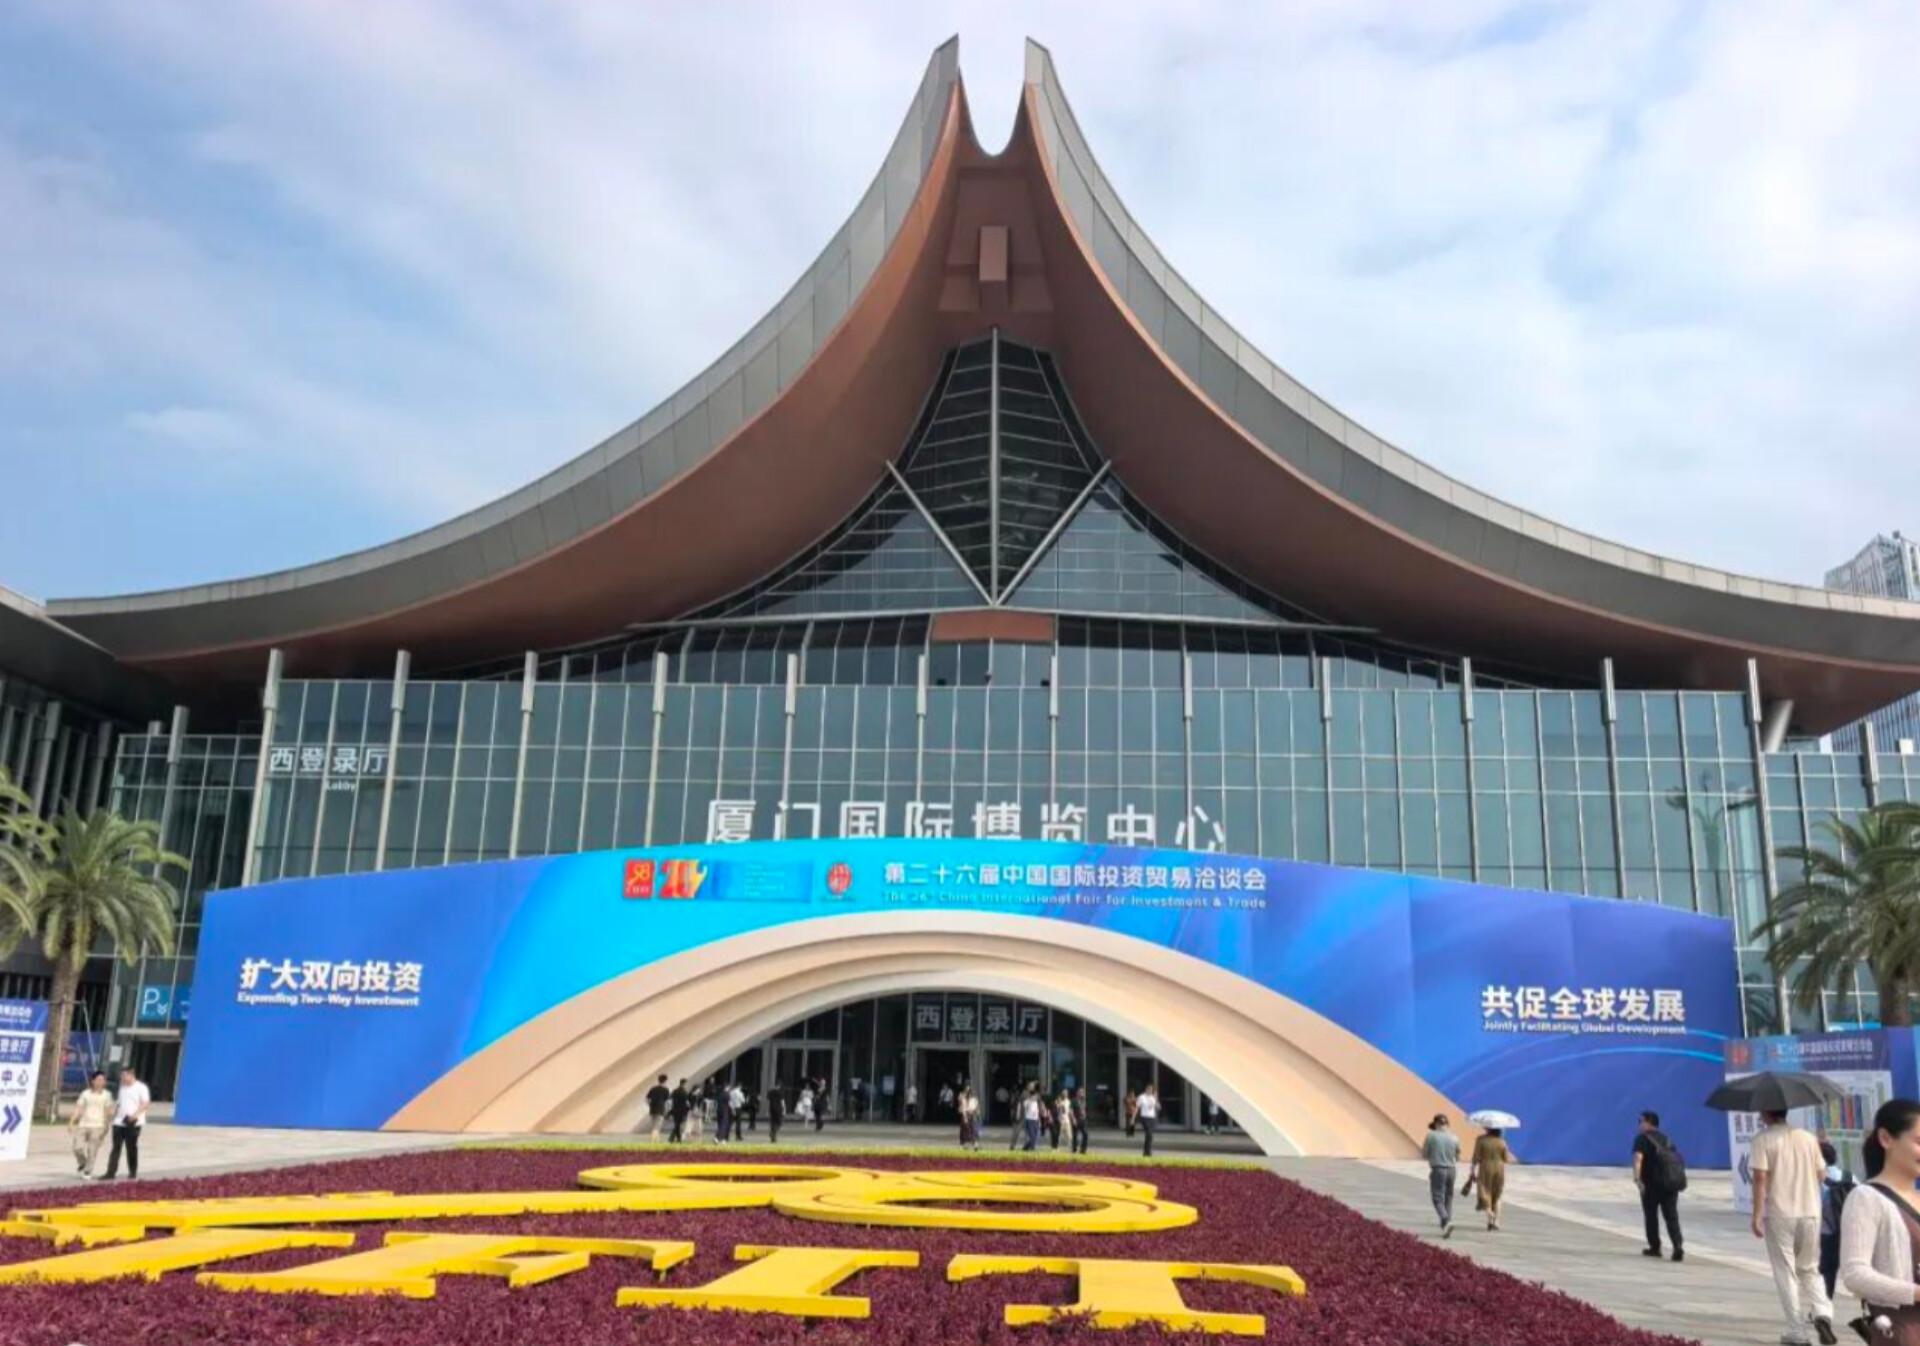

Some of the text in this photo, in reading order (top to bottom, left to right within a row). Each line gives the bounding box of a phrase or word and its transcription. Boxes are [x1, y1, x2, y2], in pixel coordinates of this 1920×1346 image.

[270, 746, 389, 773] 西登录厅
[706, 799, 1226, 853] 厦门国际博览中心
[884, 863, 1267, 890] 第二十六届中国国际投资贸易洽谈会
[1075, 893, 1100, 906] Fair
[1106, 894, 1126, 906] for
[1131, 895, 1208, 908] Investment
[1228, 898, 1267, 909] Trade
[240, 958, 422, 992] 扩大双向投资
[141, 987, 160, 1016] P
[237, 991, 298, 1006] Expanding
[354, 995, 419, 1006] Investment
[1482, 984, 1686, 1022] 共促全球发展
[916, 1005, 1044, 1032] 西登录厅
[1484, 1021, 1687, 1036] Jointly Facilitating Global Development
